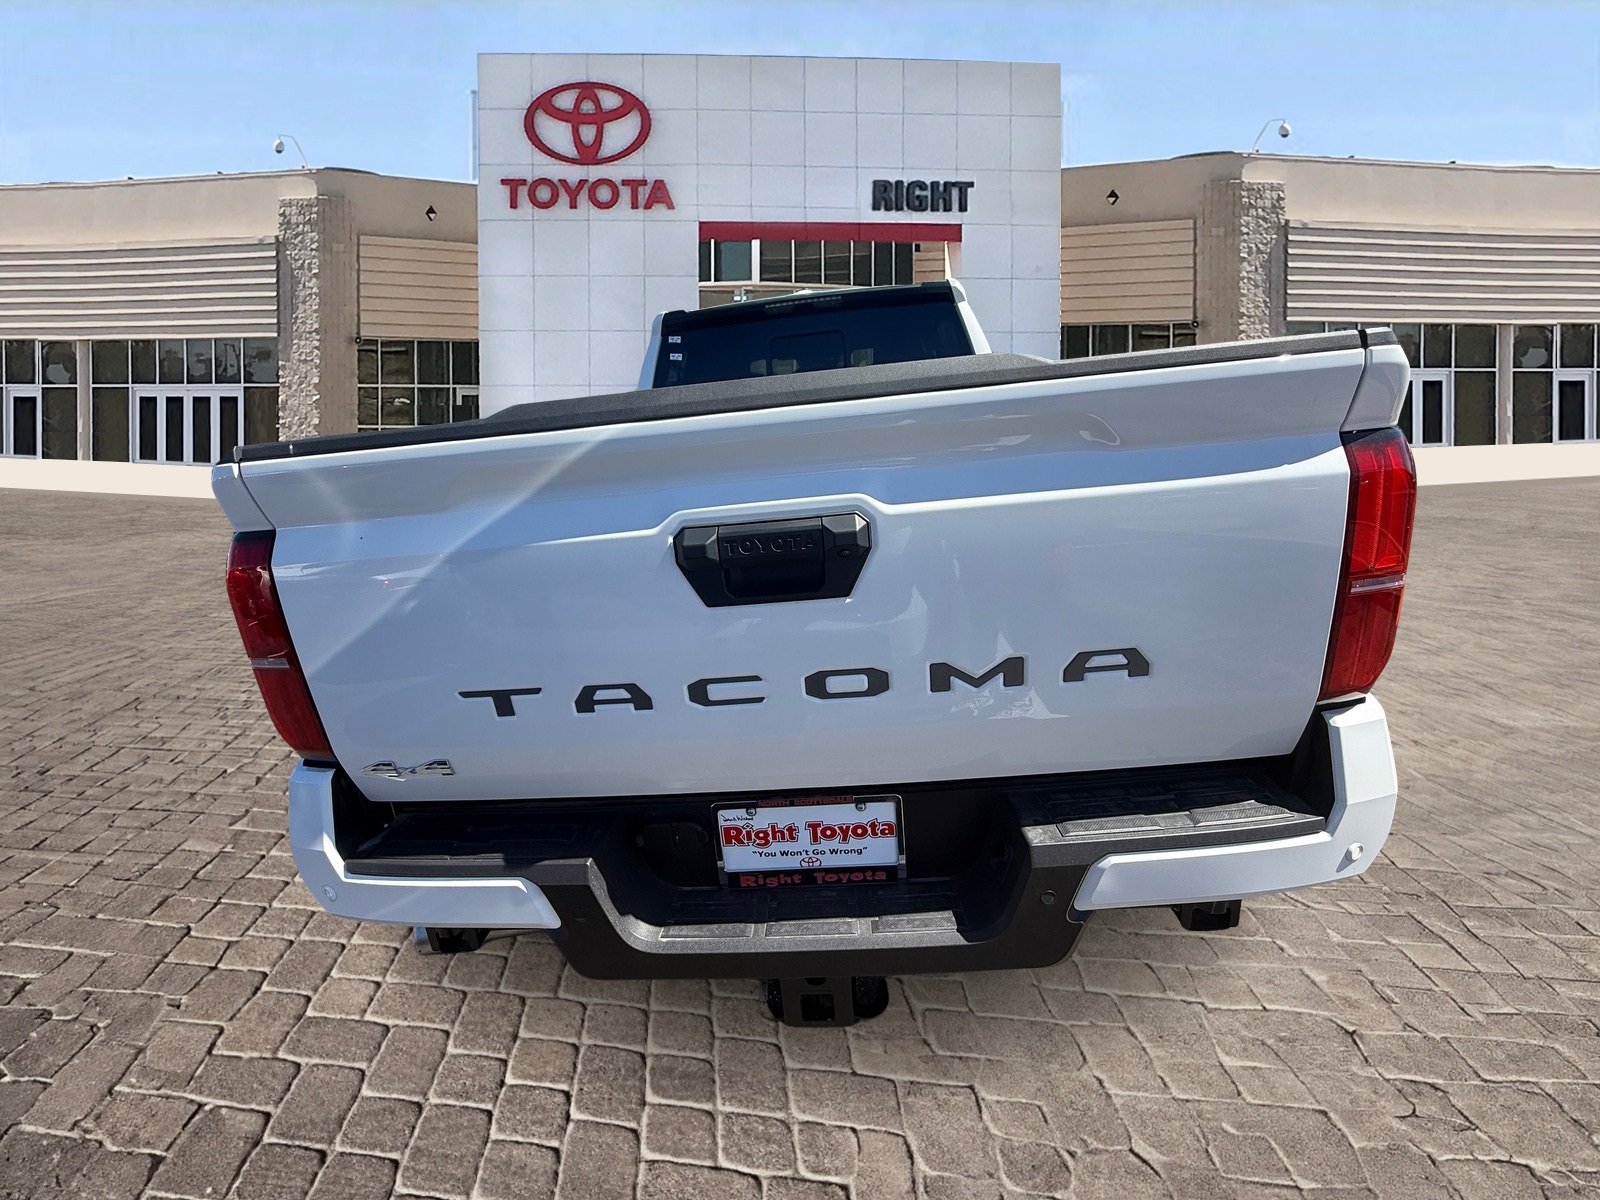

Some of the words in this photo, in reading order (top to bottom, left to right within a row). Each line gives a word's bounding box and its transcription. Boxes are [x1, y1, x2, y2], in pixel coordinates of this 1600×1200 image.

[500, 177, 675, 211] TOYOTA
[871, 178, 975, 213] RIGHT
[723, 533, 816, 557] TOYOTA
[457, 646, 1152, 719] TACOMA
[757, 798, 790, 808] NORTH
[721, 822, 799, 849] Right
[804, 818, 897, 846] Toyota
[811, 848, 826, 856] Go
[738, 873, 803, 888] Right
[813, 869, 887, 885] Toyota
